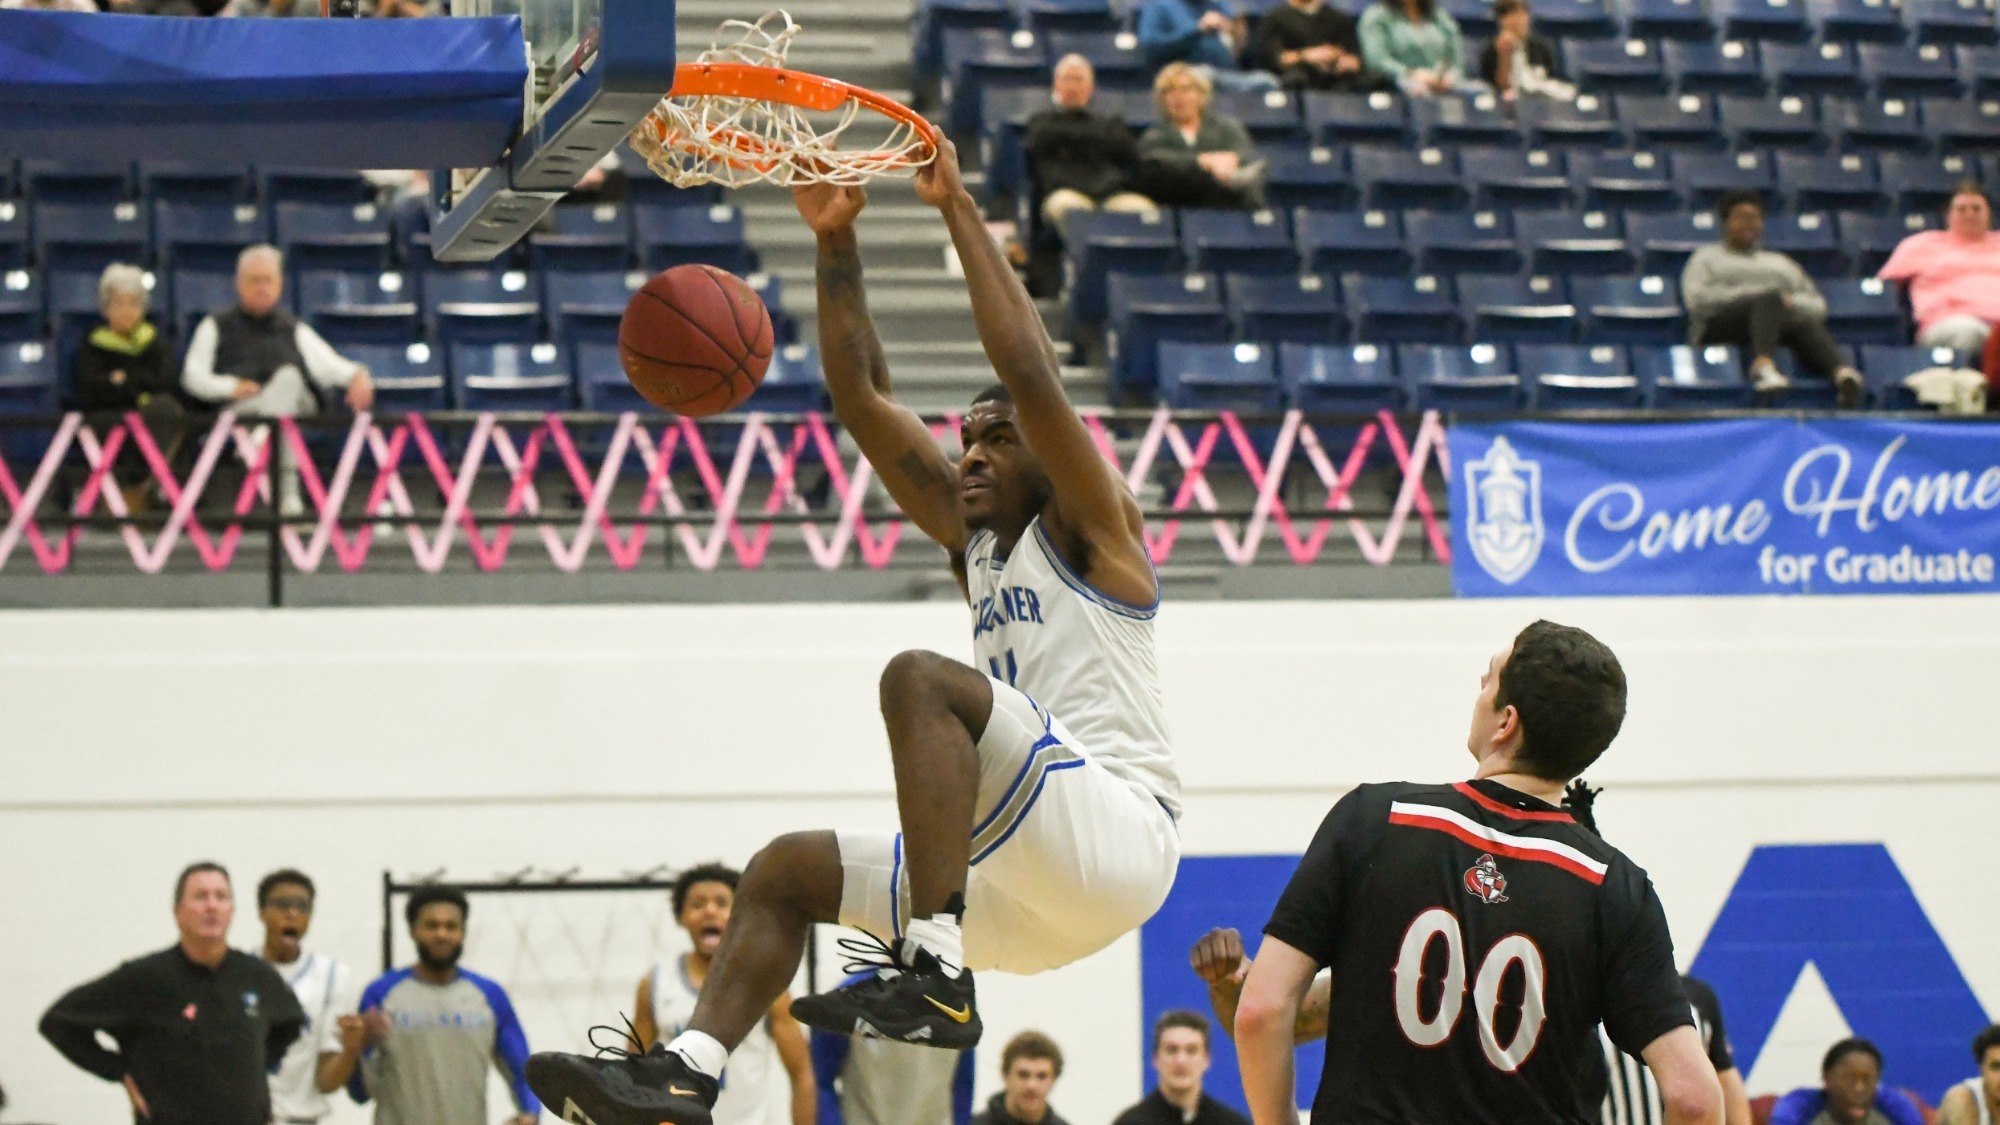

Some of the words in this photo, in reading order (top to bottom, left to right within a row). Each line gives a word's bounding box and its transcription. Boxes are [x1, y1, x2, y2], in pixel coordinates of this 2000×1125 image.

[1565, 483, 1772, 572] Come
[1784, 435, 2000, 537] Home
[1760, 546, 1814, 584] for
[1826, 547, 1994, 584] Graduate
[1391, 907, 1547, 1074] 00
